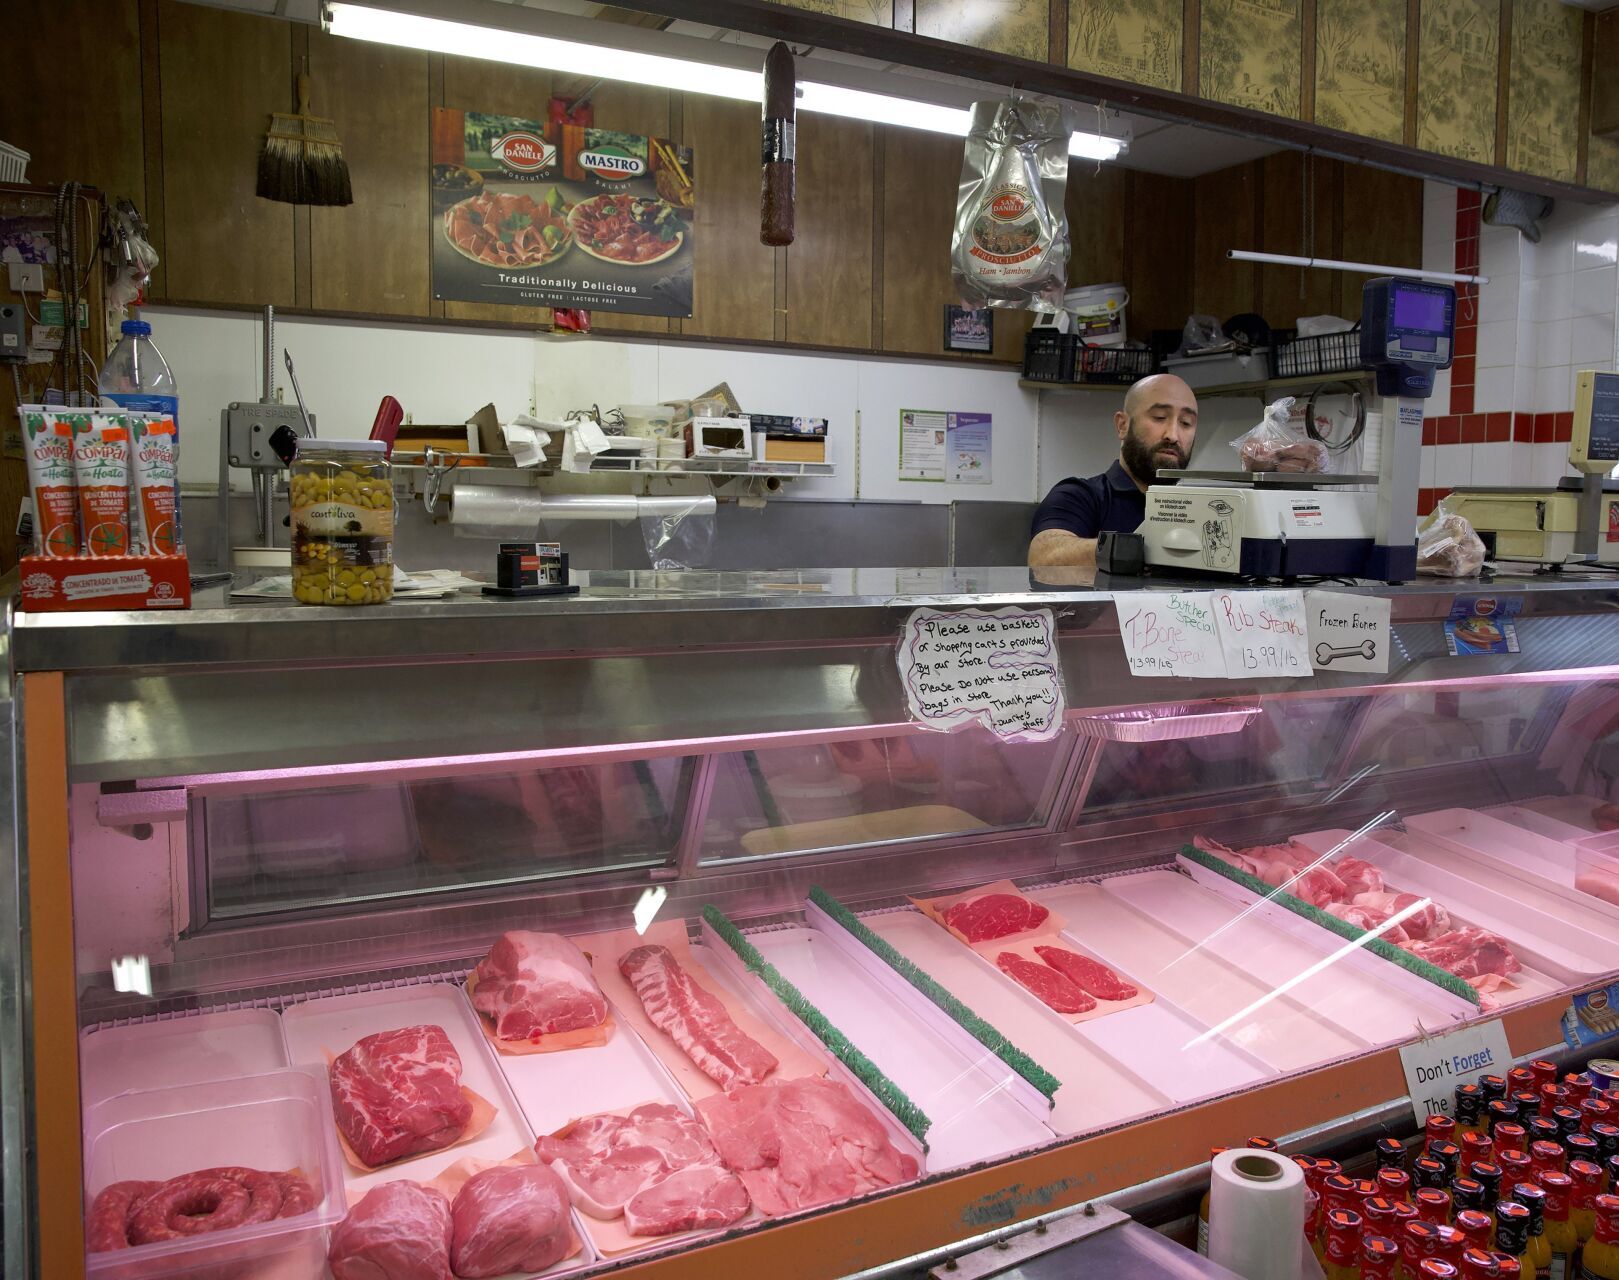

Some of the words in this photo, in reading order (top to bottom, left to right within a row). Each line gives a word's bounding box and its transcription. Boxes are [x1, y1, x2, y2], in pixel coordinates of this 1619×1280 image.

[505, 149, 543, 160] DANIELE
[514, 142, 533, 151] SAN
[585, 154, 640, 172] MASTRO
[991, 182, 1028, 194] CLASSICO
[976, 248, 1036, 264] PROSCIUTTO
[979, 267, 997, 275] Ham
[1002, 267, 1031, 276] Jambon
[498, 273, 578, 290] Traditionally
[582, 280, 638, 294] Delicious
[572, 295, 599, 304] LACTOSE
[241, 407, 262, 417] TRE
[265, 407, 298, 418] SPADE
[99, 498, 125, 506] TOMATE
[1167, 594, 1209, 619] Butcher
[1220, 595, 1254, 632] Rib
[924, 621, 971, 639] Please
[977, 622, 997, 633] use
[1001, 618, 1041, 631] baskets
[1125, 608, 1187, 652] T-Bone
[1176, 611, 1216, 636] Special
[1258, 610, 1304, 636] Steak
[1319, 609, 1349, 628] Frozen
[1352, 612, 1378, 631] Bones
[933, 640, 973, 658] shopping
[1010, 635, 1048, 650] provided
[915, 662, 931, 680] By
[934, 661, 950, 671] our
[957, 656, 987, 668] store.
[919, 681, 955, 696] Please
[957, 679, 973, 689] Do
[974, 676, 995, 688] Not
[997, 672, 1020, 684] use
[922, 698, 950, 717] bags
[952, 694, 963, 706] in
[966, 691, 993, 702] store
[989, 694, 1023, 711] Thank
[1416, 1058, 1453, 1084] Don't
[1453, 1047, 1494, 1073] Forget
[1423, 1097, 1449, 1116] The
